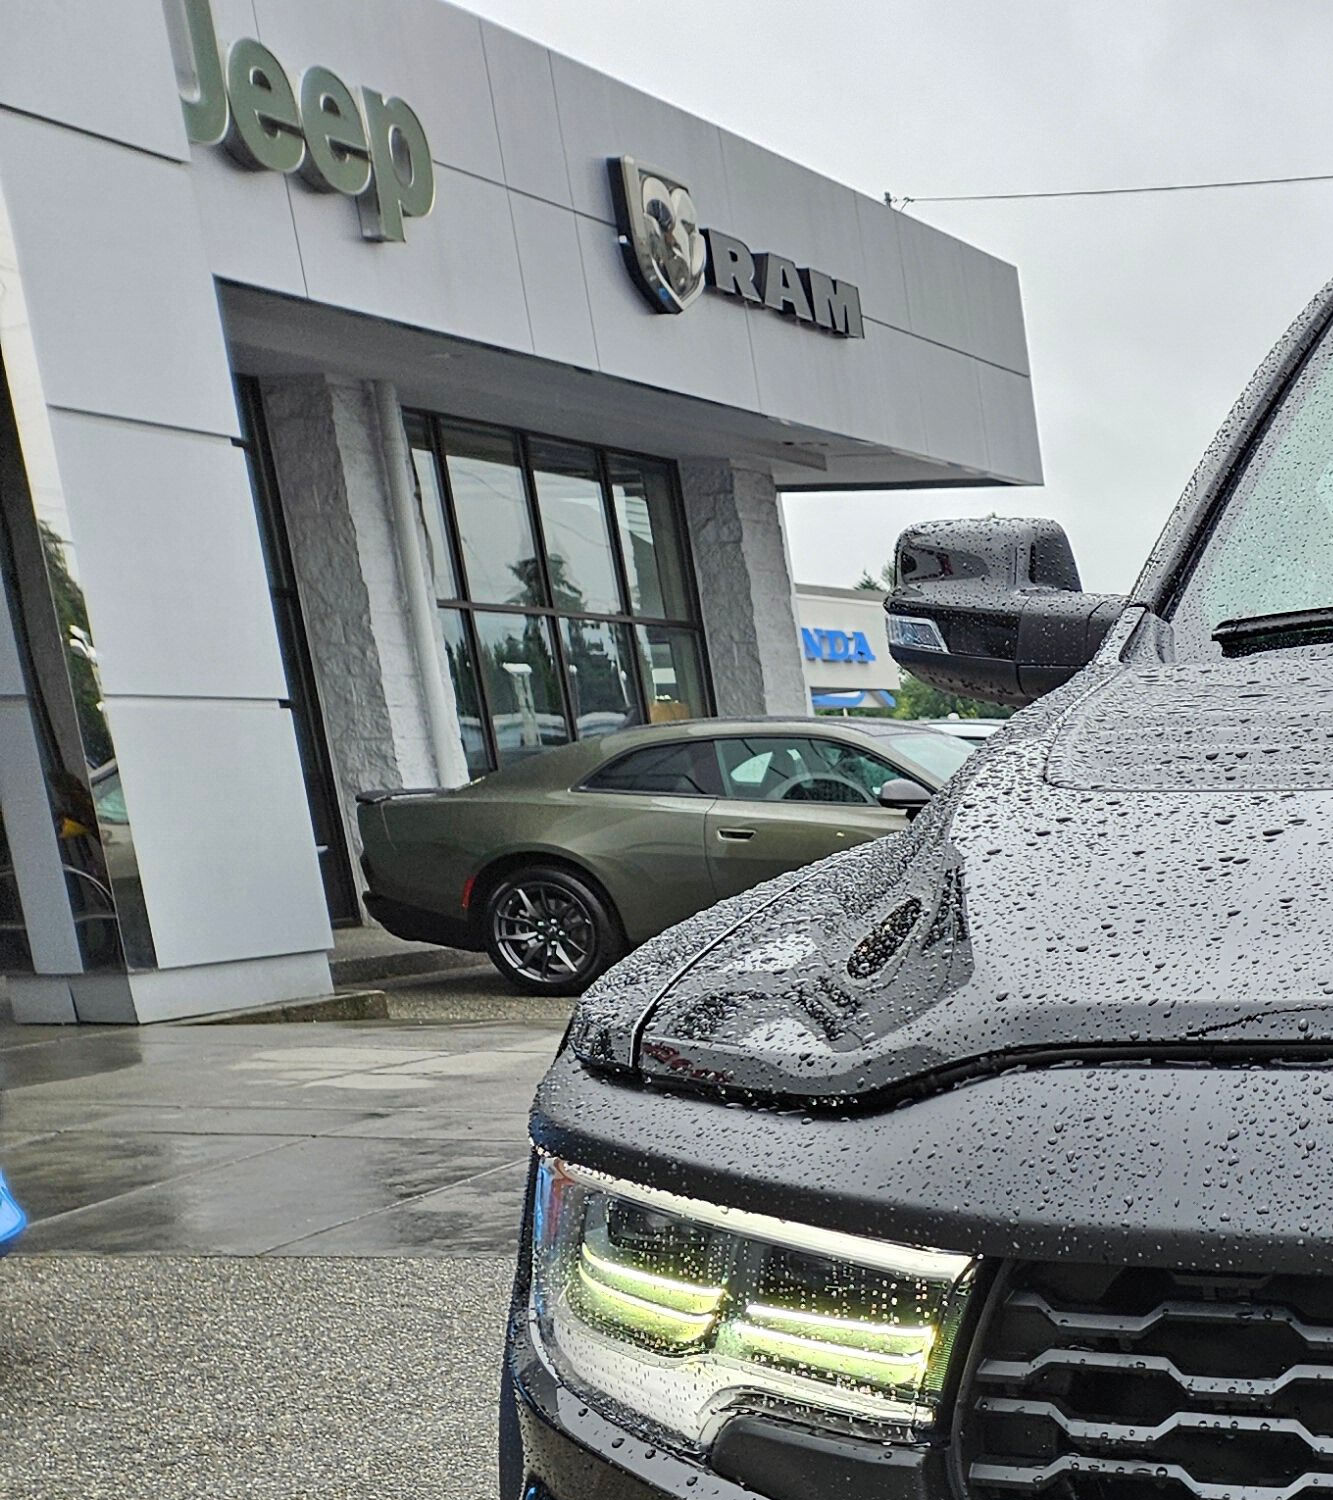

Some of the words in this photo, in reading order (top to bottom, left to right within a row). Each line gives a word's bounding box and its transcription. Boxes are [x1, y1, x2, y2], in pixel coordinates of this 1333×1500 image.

[163, 0, 436, 242] Jeep
[702, 227, 866, 340] RAM
[800, 627, 877, 663] NDA
